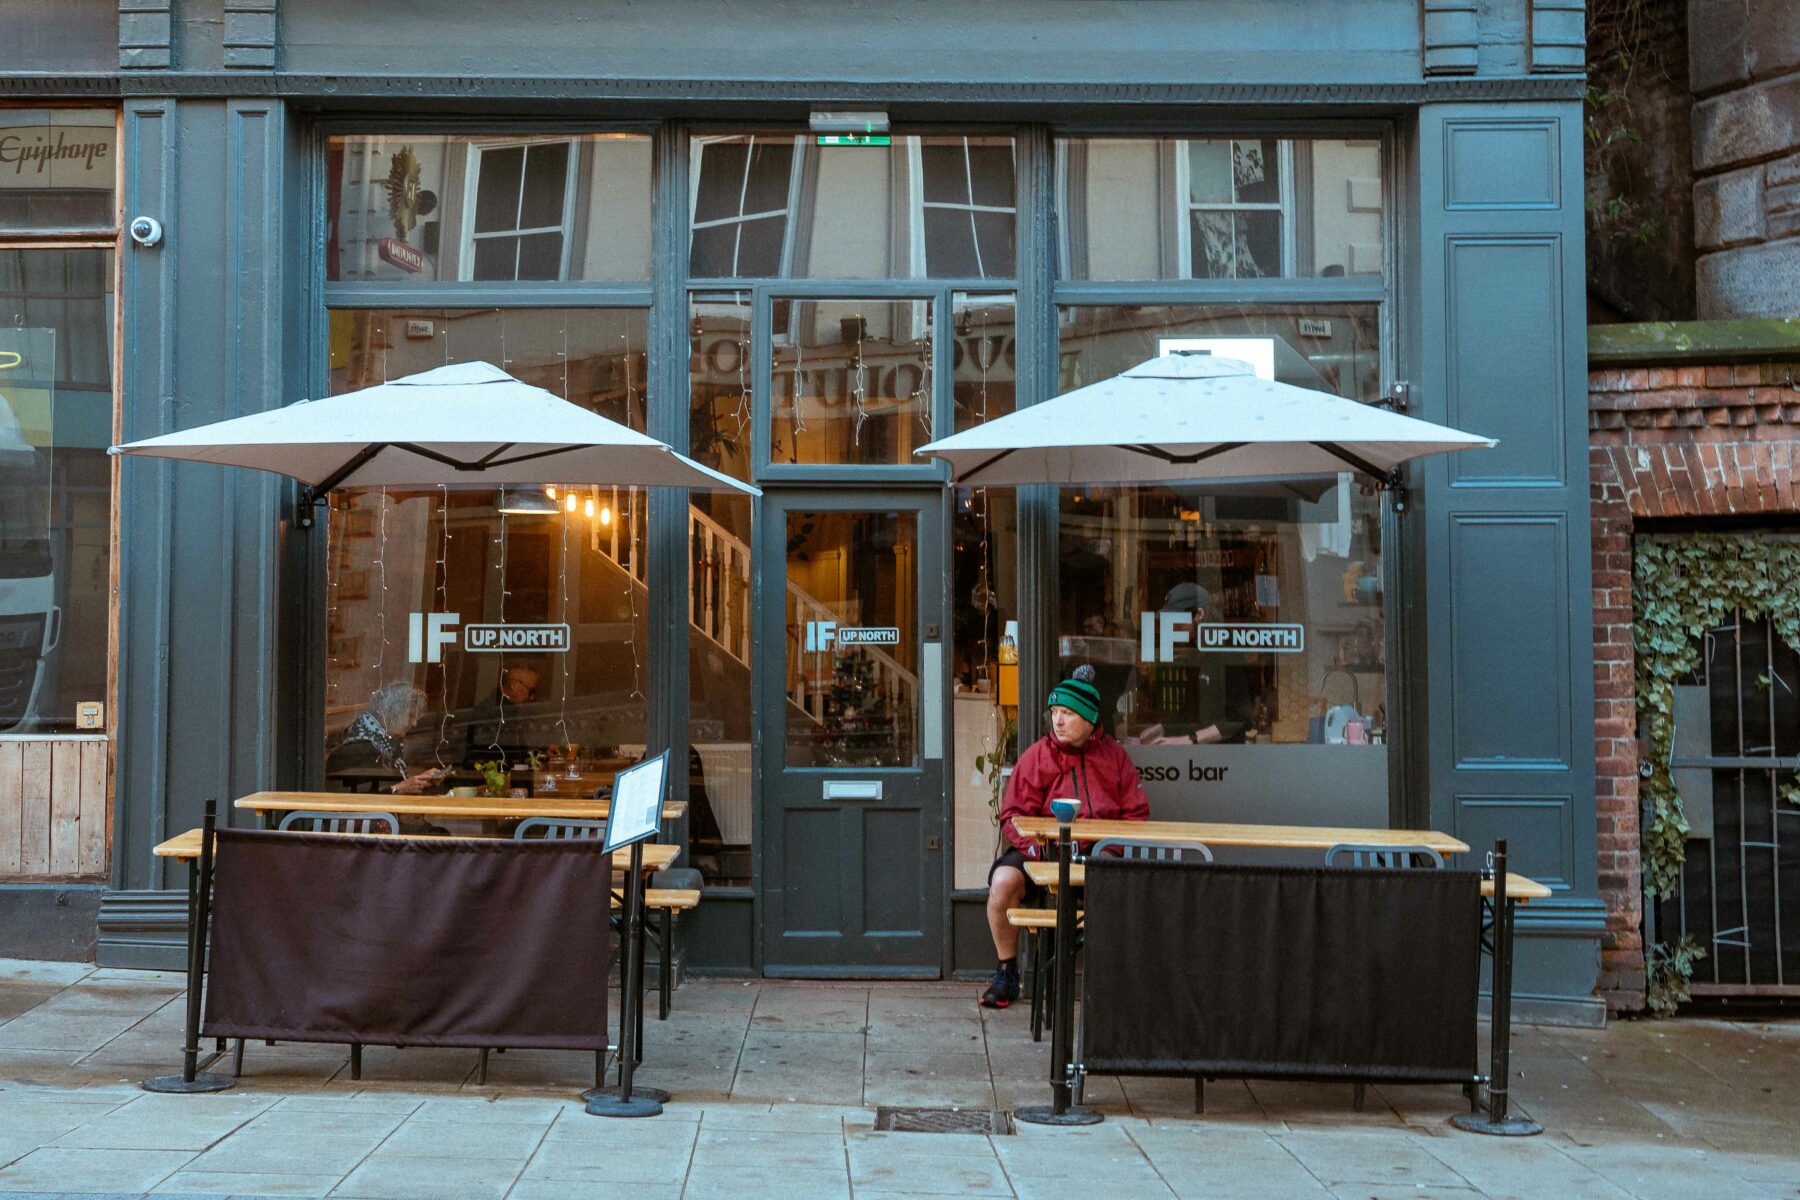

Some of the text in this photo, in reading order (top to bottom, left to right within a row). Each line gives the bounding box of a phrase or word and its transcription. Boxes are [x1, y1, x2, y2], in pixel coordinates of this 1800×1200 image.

[0, 132, 108, 174] Epiphone
[408, 612, 563, 663] IF UP NORTH
[806, 621, 895, 652] IF UP NORTH
[1141, 611, 1297, 662] IF UP NORTH
[1135, 759, 1229, 781] esso bar
